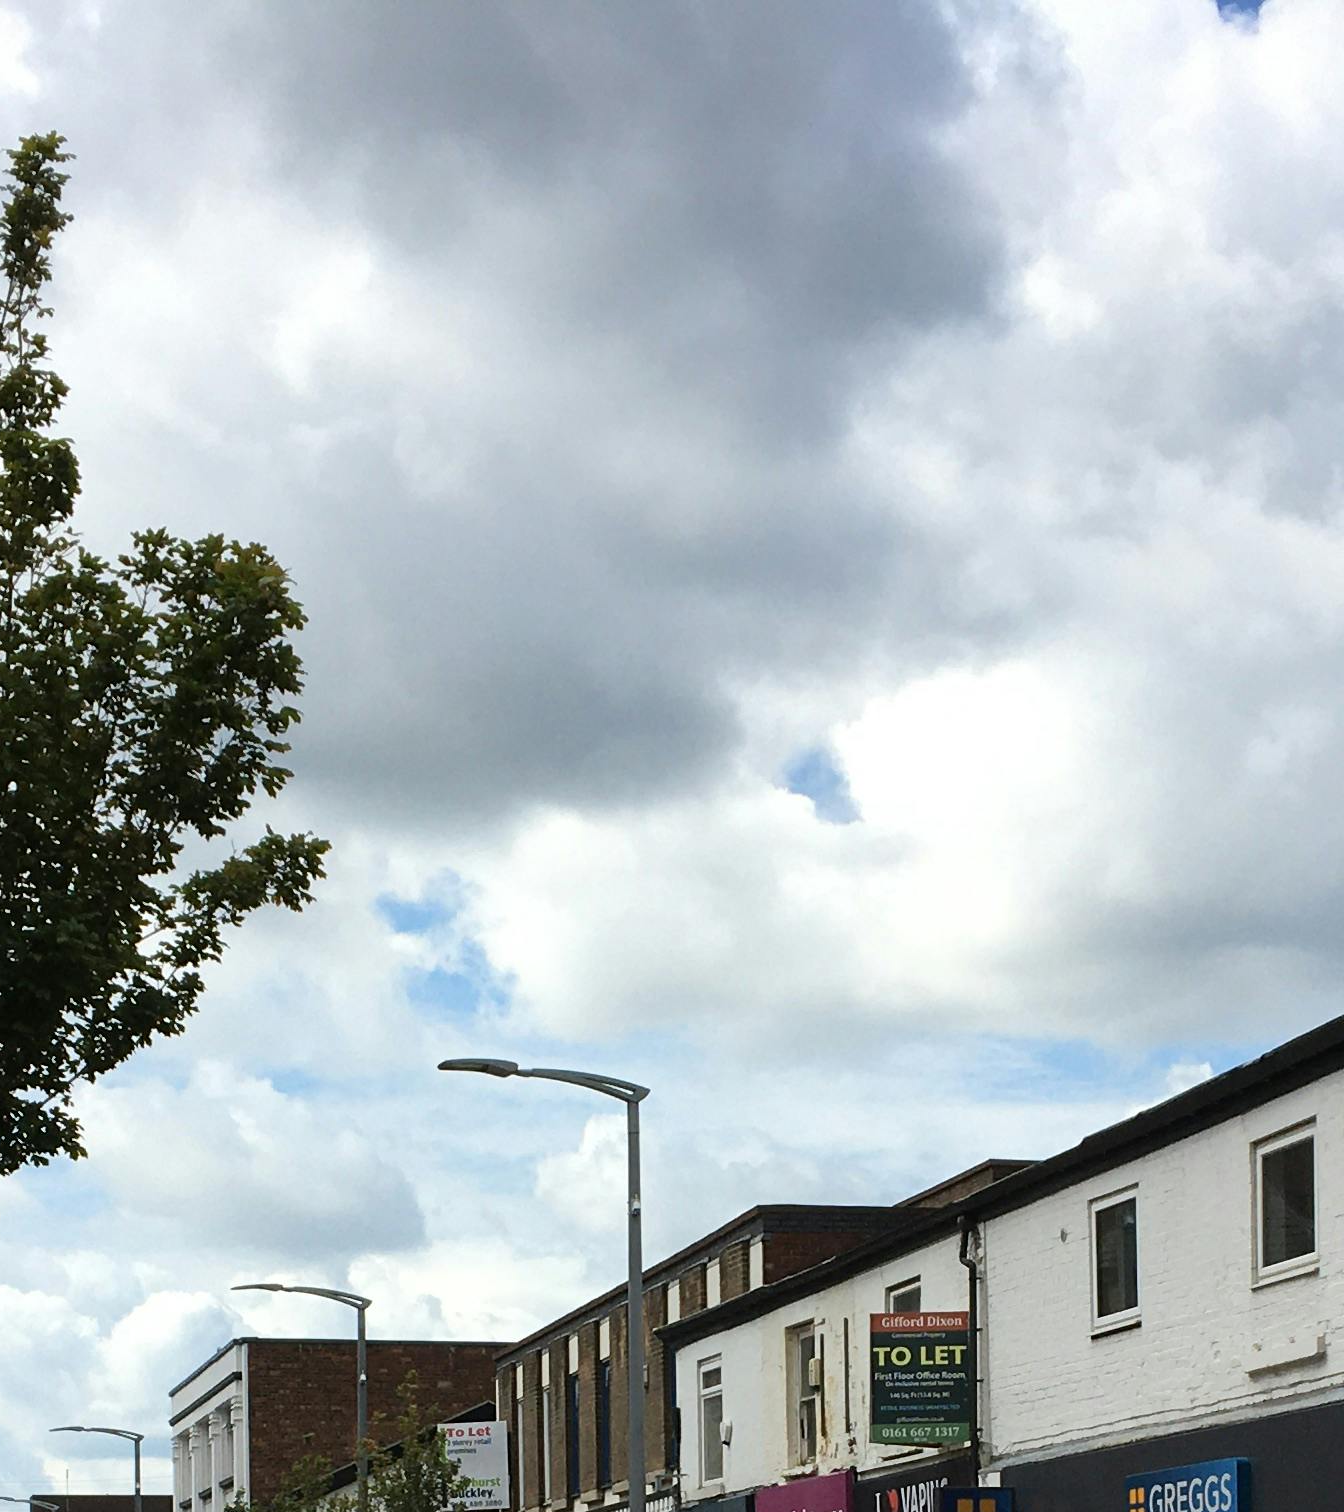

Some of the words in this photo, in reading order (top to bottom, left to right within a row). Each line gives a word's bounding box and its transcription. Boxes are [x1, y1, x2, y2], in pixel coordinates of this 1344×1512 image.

[881, 1316, 924, 1328] Gifford
[927, 1315, 963, 1327] Dixon
[872, 1346, 912, 1367] TO
[920, 1345, 967, 1365] LET
[874, 1372, 893, 1380] First
[893, 1371, 915, 1380] Floor
[915, 1371, 941, 1380] Office
[941, 1371, 966, 1380] Room
[446, 1427, 464, 1437] To
[468, 1426, 491, 1437] Let
[881, 1427, 907, 1438] 0161
[910, 1427, 931, 1438] 667
[935, 1426, 960, 1437] 1317
